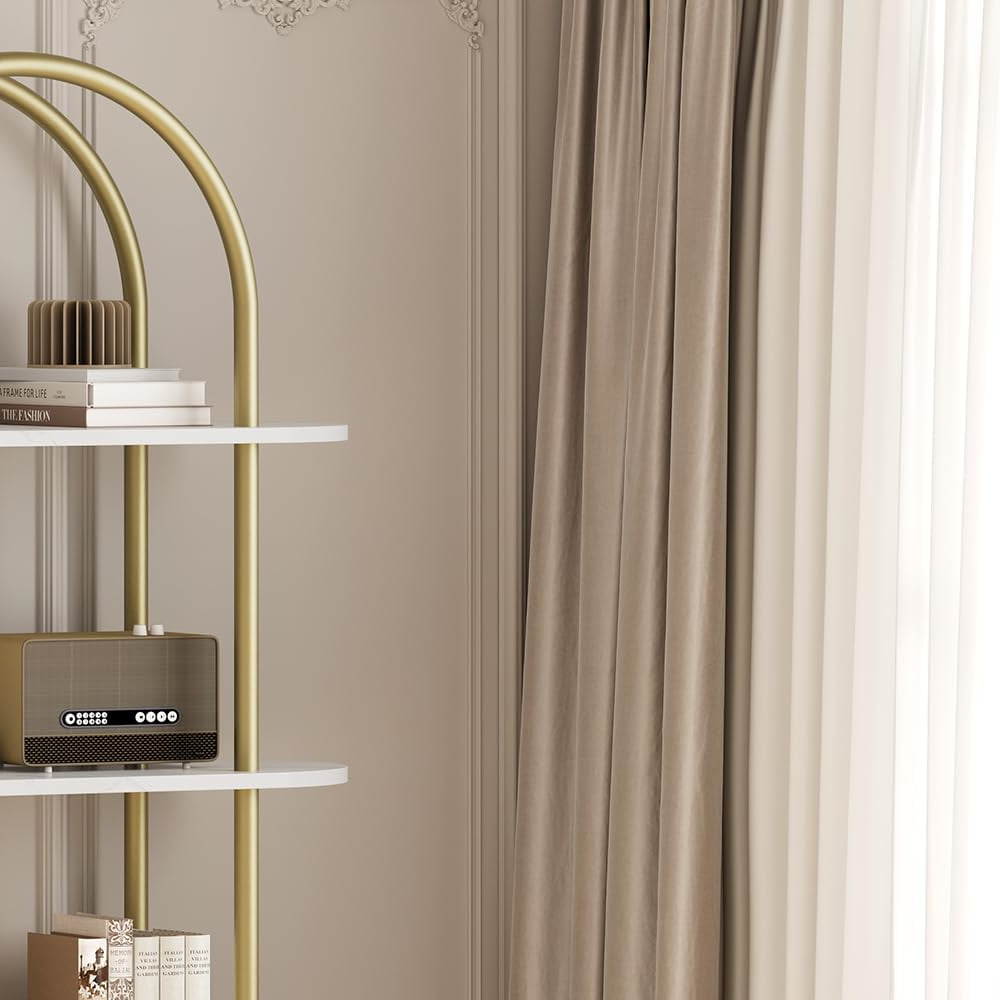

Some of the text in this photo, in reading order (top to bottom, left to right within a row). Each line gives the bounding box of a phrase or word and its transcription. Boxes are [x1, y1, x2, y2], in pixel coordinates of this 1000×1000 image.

[3, 387, 22, 398] FRAME
[23, 388, 35, 399] FOR
[35, 388, 47, 399] LIFE
[1, 408, 51, 422] THE FASHION
